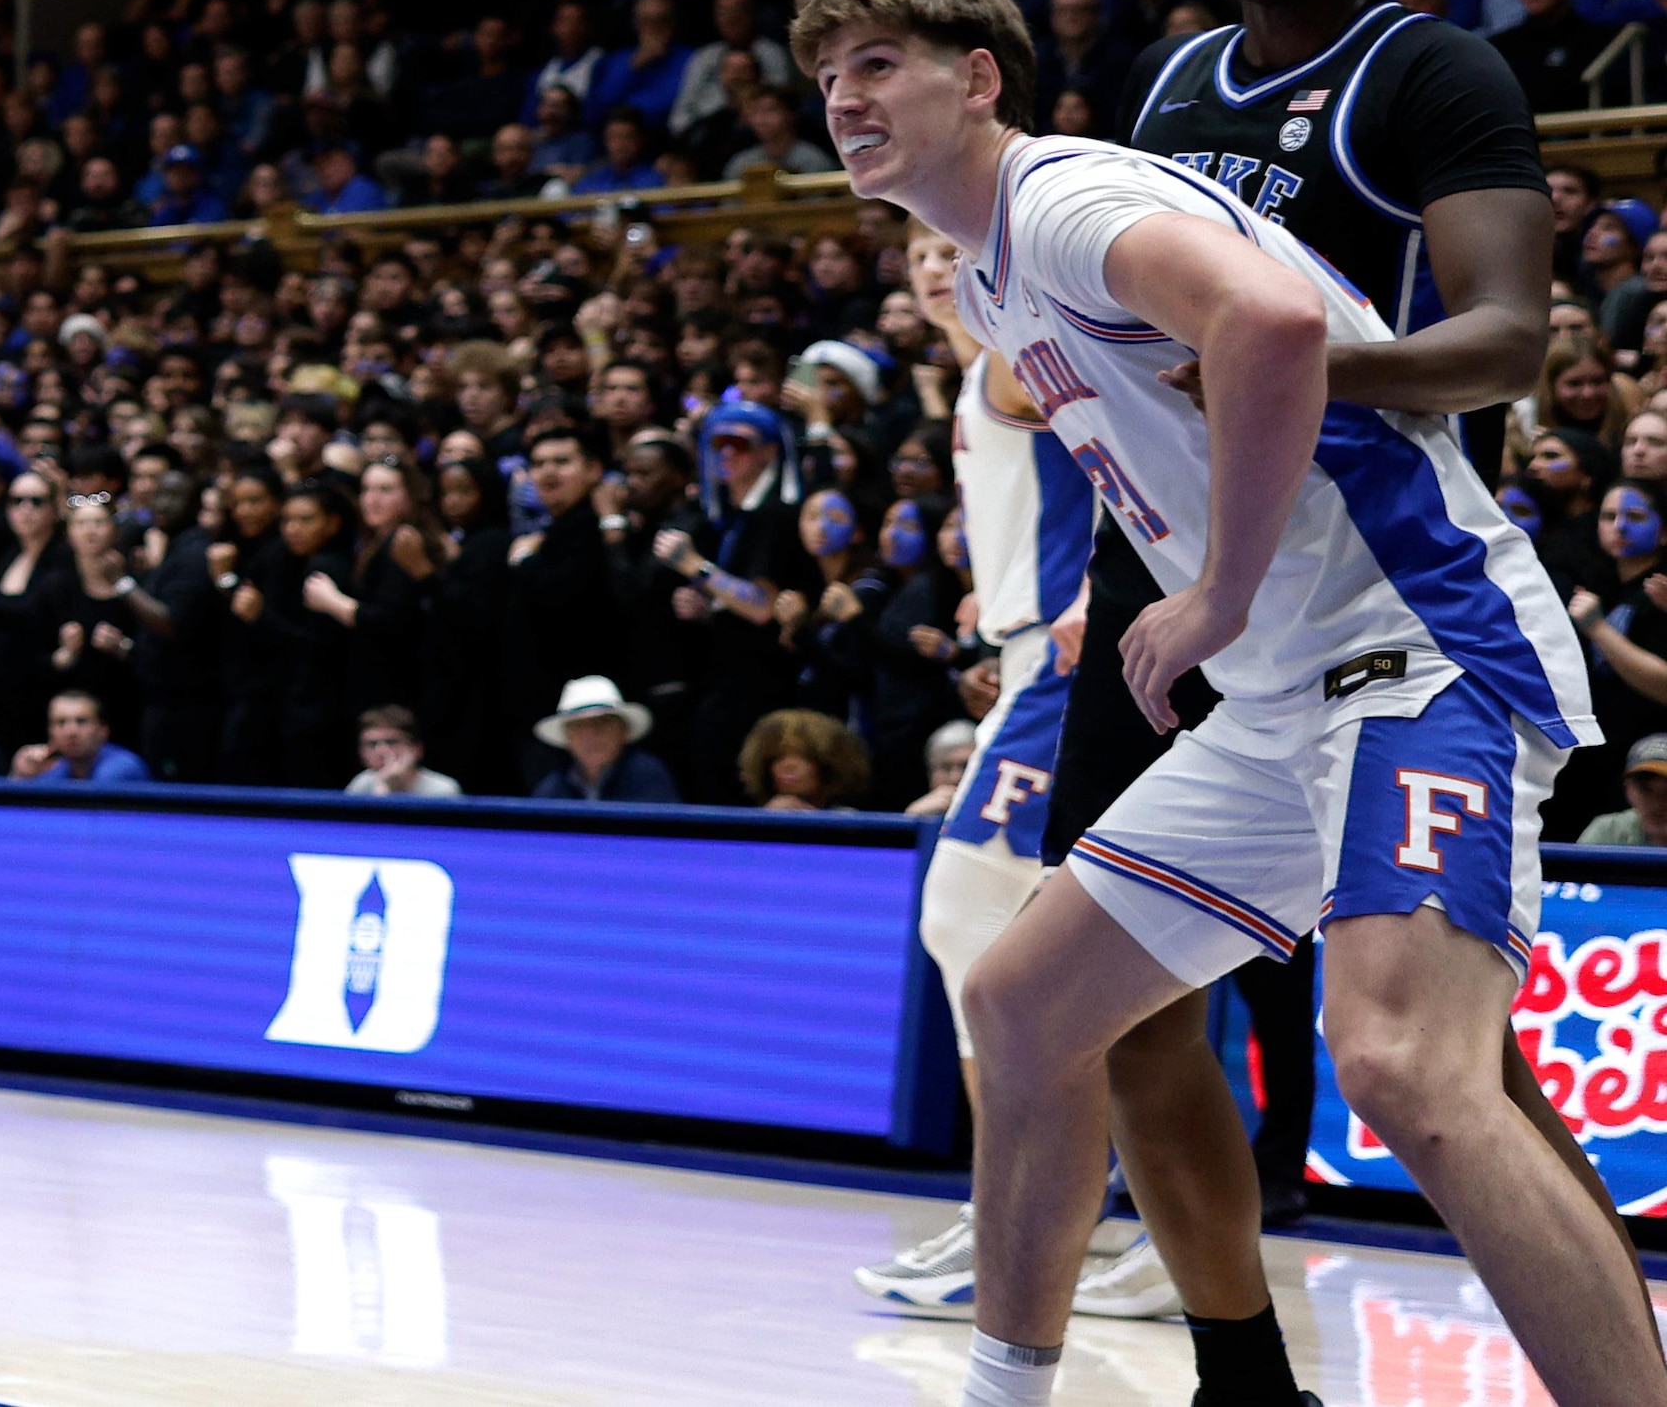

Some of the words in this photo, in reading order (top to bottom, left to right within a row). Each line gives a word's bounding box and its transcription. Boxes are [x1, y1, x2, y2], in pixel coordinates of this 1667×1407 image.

[1373, 658, 1393, 671] 50
[981, 758, 1054, 825] F
[1395, 767, 1489, 874] F
